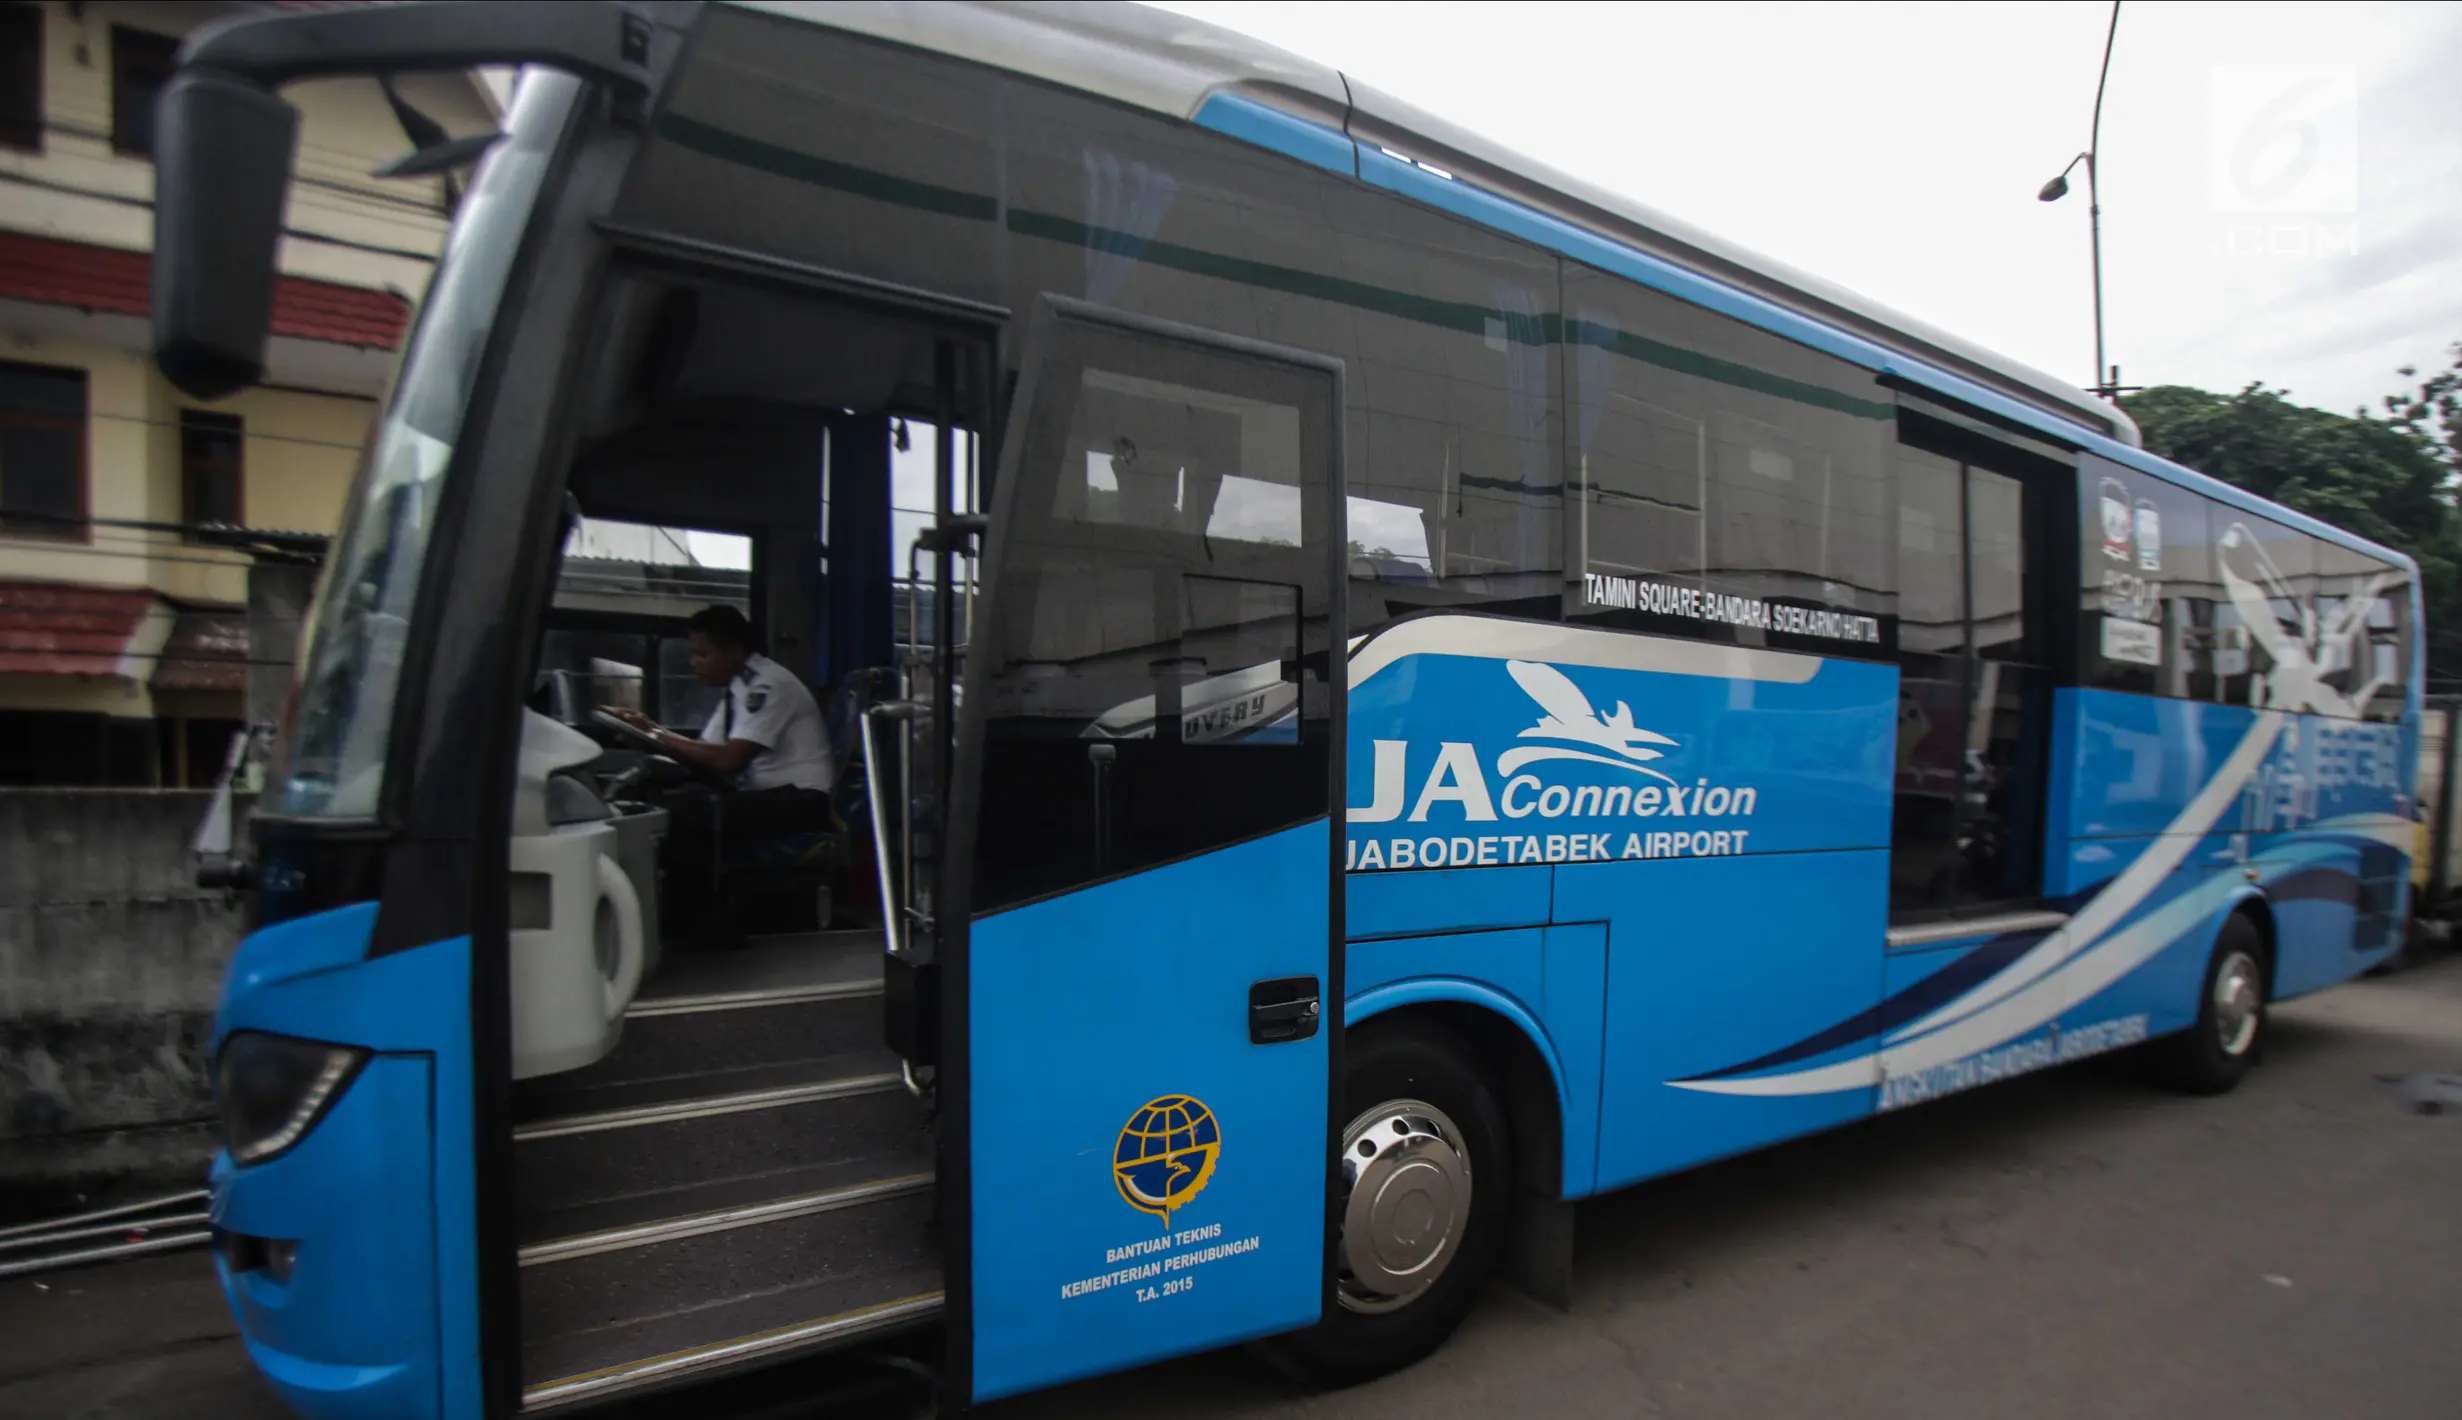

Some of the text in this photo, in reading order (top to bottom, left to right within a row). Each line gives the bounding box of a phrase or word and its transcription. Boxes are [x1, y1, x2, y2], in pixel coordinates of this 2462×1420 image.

[1585, 573, 1880, 643] TAMINI SQUARE-BANDARA SOEKARNO HATTA
[1346, 739, 1757, 823] JA Connexion
[1346, 830, 1749, 870] JABODETABEK AIRPORT
[1061, 1236, 1260, 1299] KEMENTERIAN PERHUBUNGAN
[1106, 1223, 1221, 1263] BANTUAN TEKNIS
[1136, 1276, 1193, 1302] T.A. 2015
